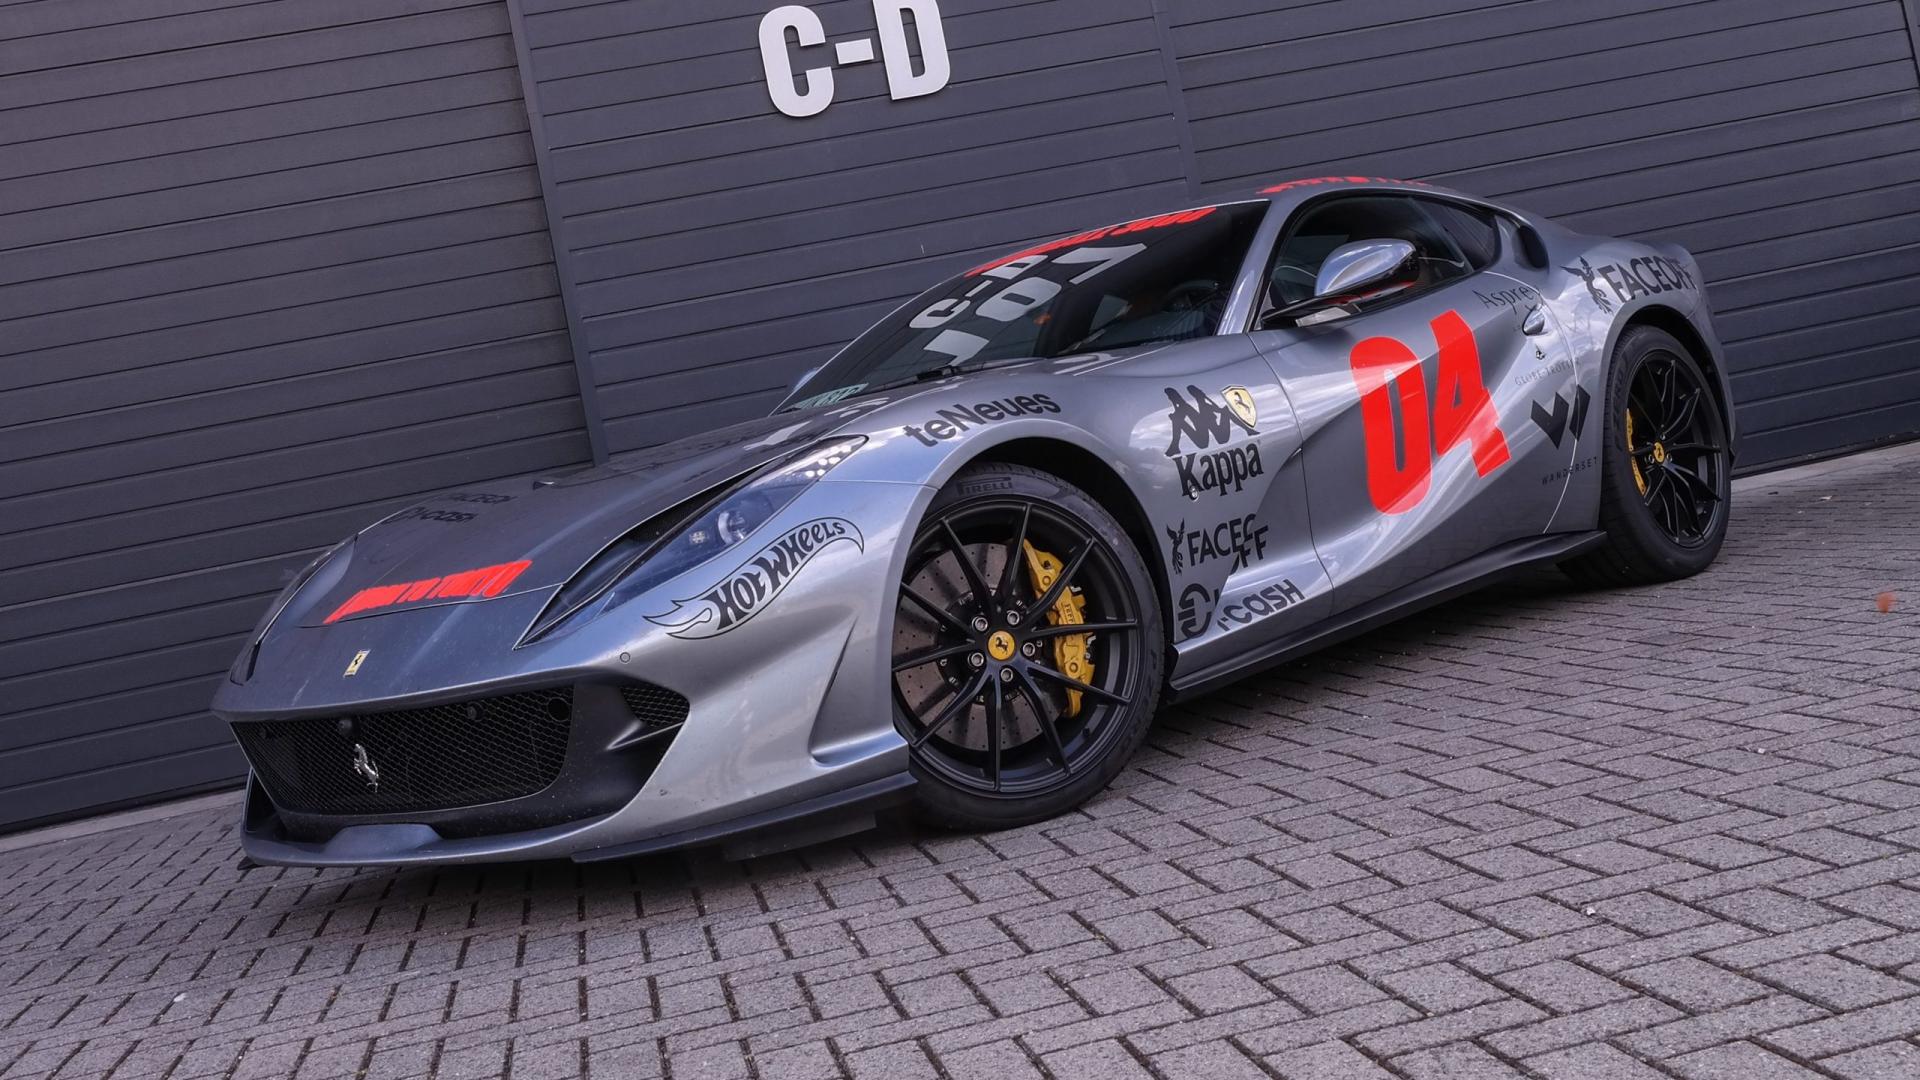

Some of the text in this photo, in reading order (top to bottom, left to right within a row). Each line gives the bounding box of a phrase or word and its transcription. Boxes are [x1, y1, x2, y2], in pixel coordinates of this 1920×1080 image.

[759, 0, 950, 117] C-D
[1597, 256, 1697, 303] FACEOFF
[903, 394, 1061, 447] teNeues
[1349, 309, 1512, 515] 04
[957, 477, 1013, 496] PIRELLI
[1174, 443, 1264, 499] Kappa
